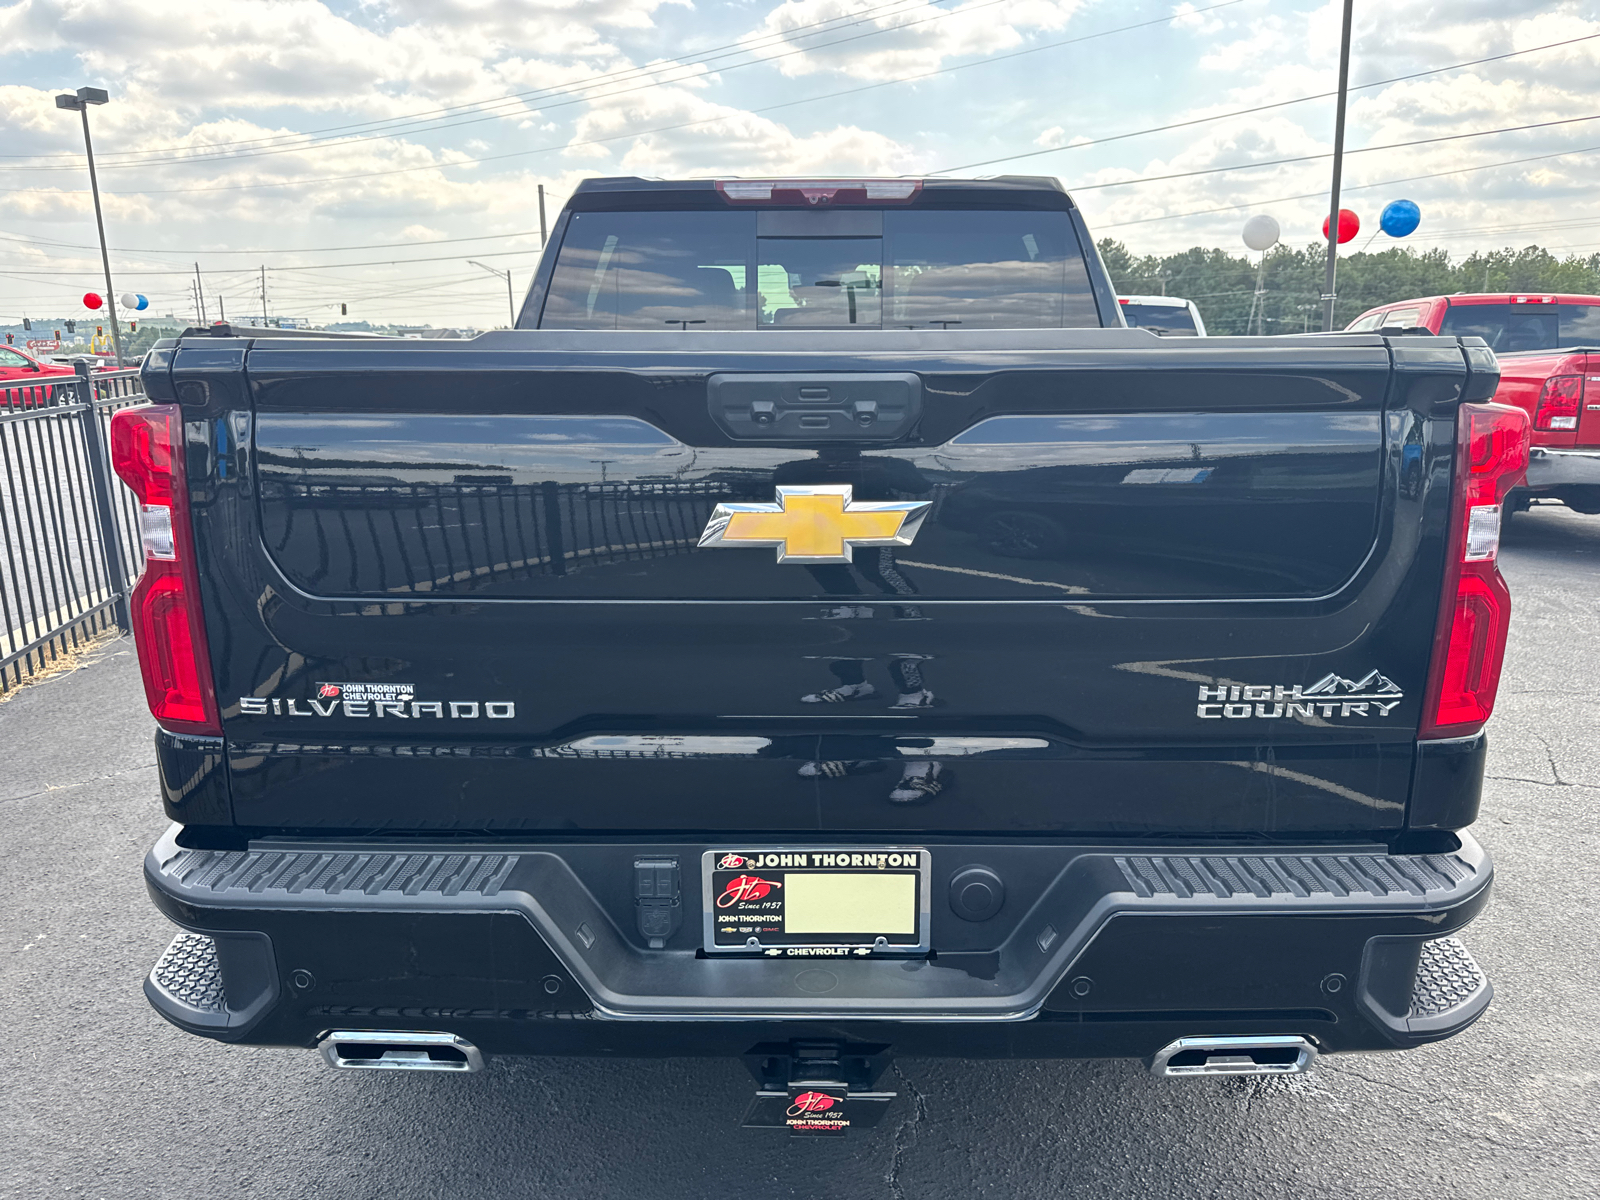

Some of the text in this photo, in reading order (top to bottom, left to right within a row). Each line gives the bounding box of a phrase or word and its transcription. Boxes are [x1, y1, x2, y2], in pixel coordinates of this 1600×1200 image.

[342, 684, 414, 694] JOHN THORNTON
[1198, 685, 1303, 701] HIGH
[343, 693, 397, 701] CHEVROLET
[240, 697, 516, 719] SILVERADO
[1197, 701, 1400, 718] COUNTRY
[756, 854, 917, 867] JOHN THORNTON
[787, 948, 850, 956] CHEVROLET
